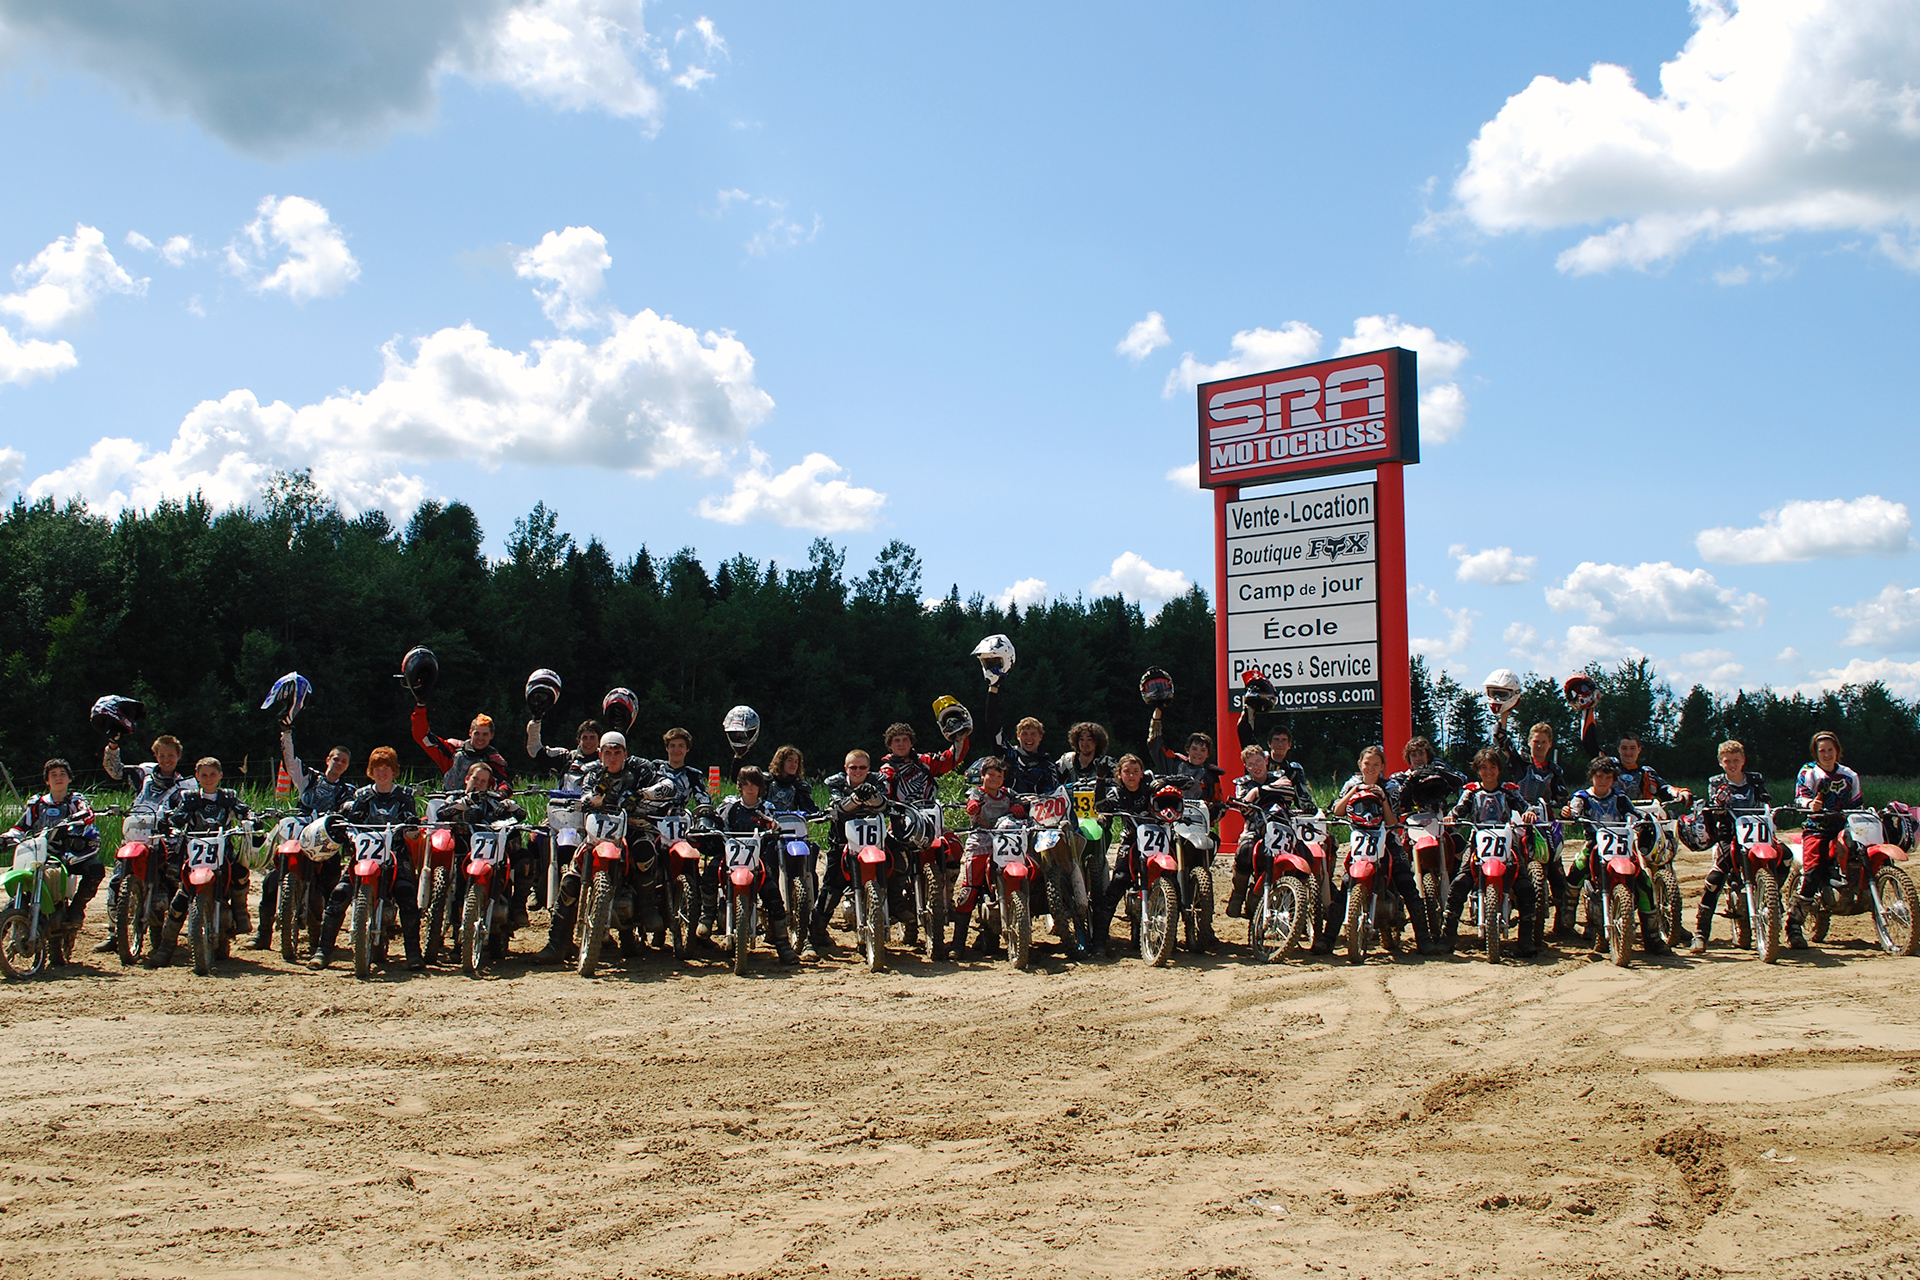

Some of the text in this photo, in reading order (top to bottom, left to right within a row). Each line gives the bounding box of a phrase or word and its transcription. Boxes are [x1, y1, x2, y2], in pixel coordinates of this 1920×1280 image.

[1209, 364, 1385, 440] SRA
[1210, 420, 1386, 469] MOTOCROSS
[1232, 494, 1369, 530] Vente Location
[1232, 544, 1302, 566] Boutique
[1239, 577, 1363, 601] Camp de jour
[1264, 618, 1338, 639] École
[1297, 661, 1304, 675] &
[1309, 653, 1371, 678] Service
[1034, 797, 1067, 822] 220
[596, 818, 619, 839] 12
[667, 819, 688, 840] 18
[856, 823, 877, 846] 16
[1742, 822, 1769, 843] 20
[358, 838, 384, 860] 22
[997, 836, 1022, 856] 23
[1144, 829, 1166, 853] 24
[1270, 827, 1295, 854] 23
[1353, 835, 1379, 856] 28
[1481, 836, 1507, 858] 26
[1602, 834, 1628, 856] 25
[191, 843, 218, 866] 29
[729, 844, 756, 867] 27
